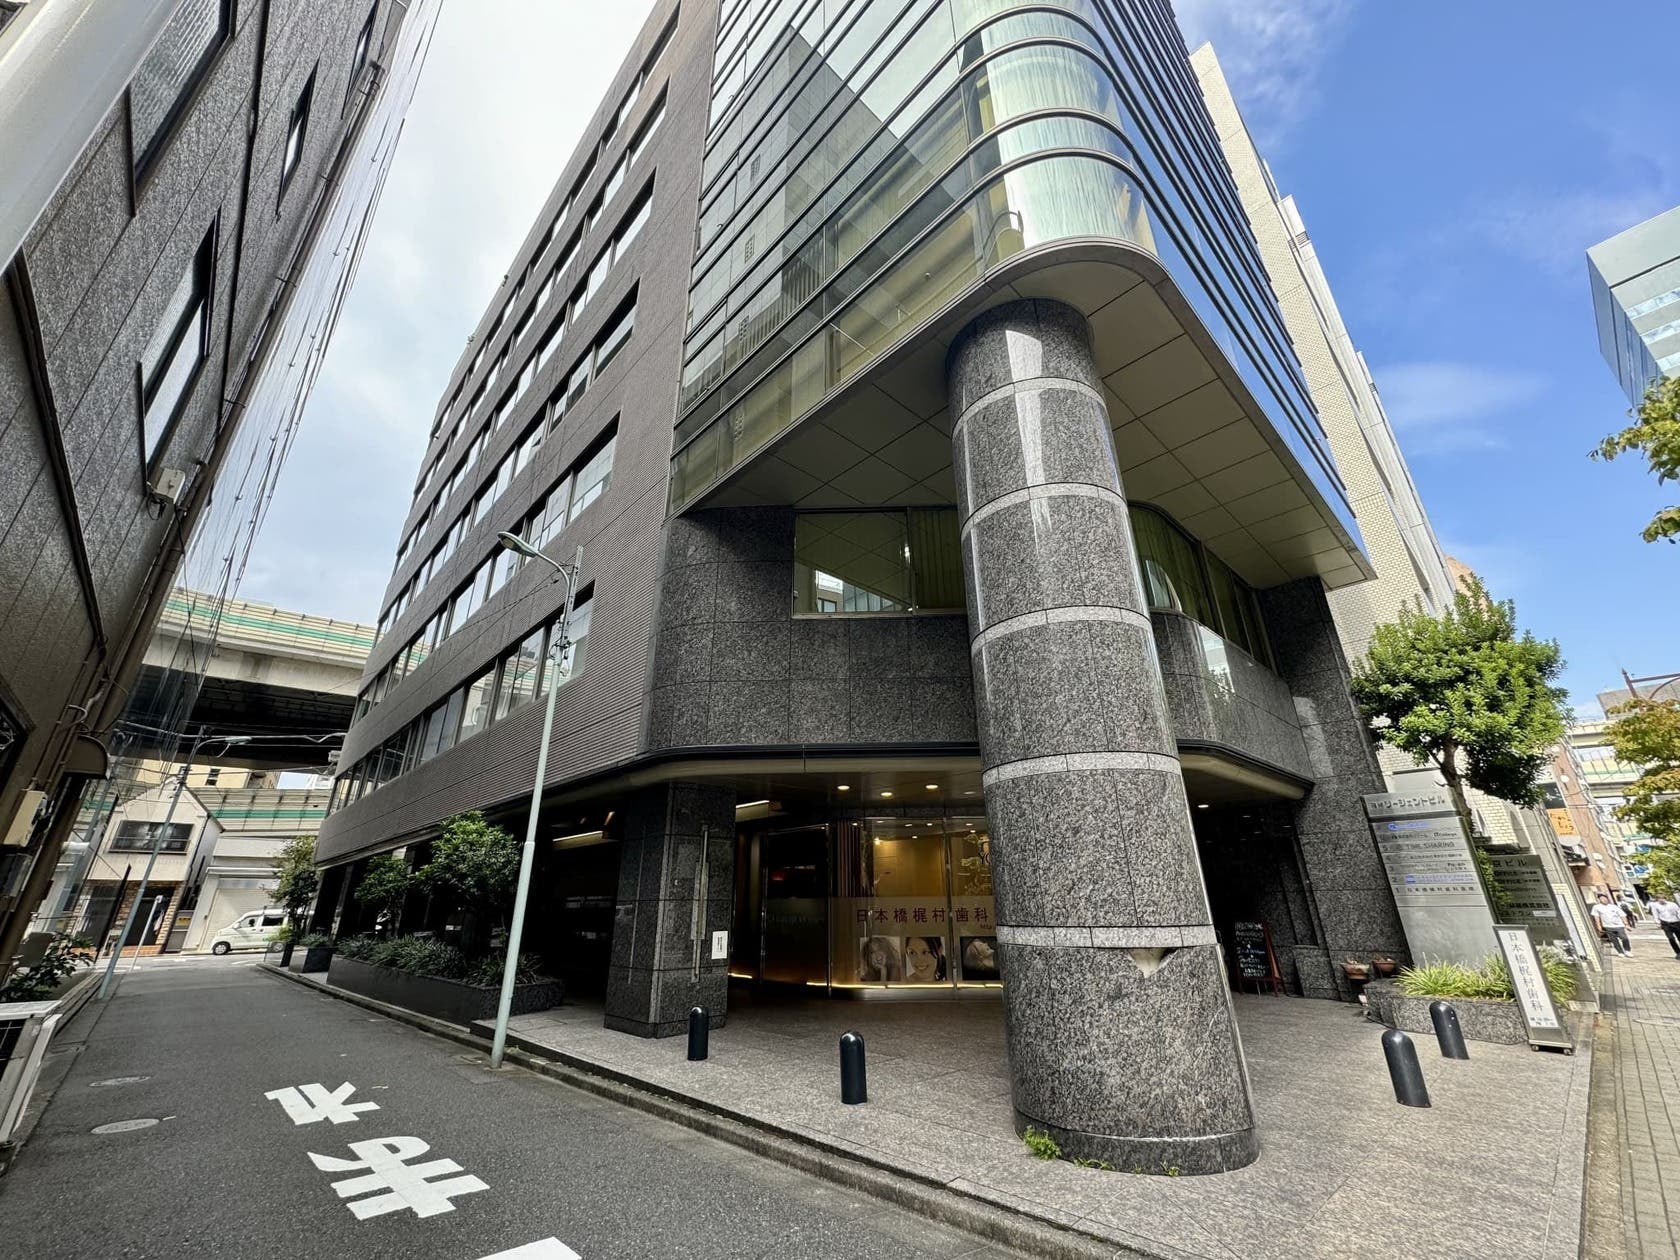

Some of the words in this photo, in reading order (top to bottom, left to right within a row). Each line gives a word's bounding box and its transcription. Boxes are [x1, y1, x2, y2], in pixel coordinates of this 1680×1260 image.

[856, 907, 989, 923] 日本橋梶村歯科
